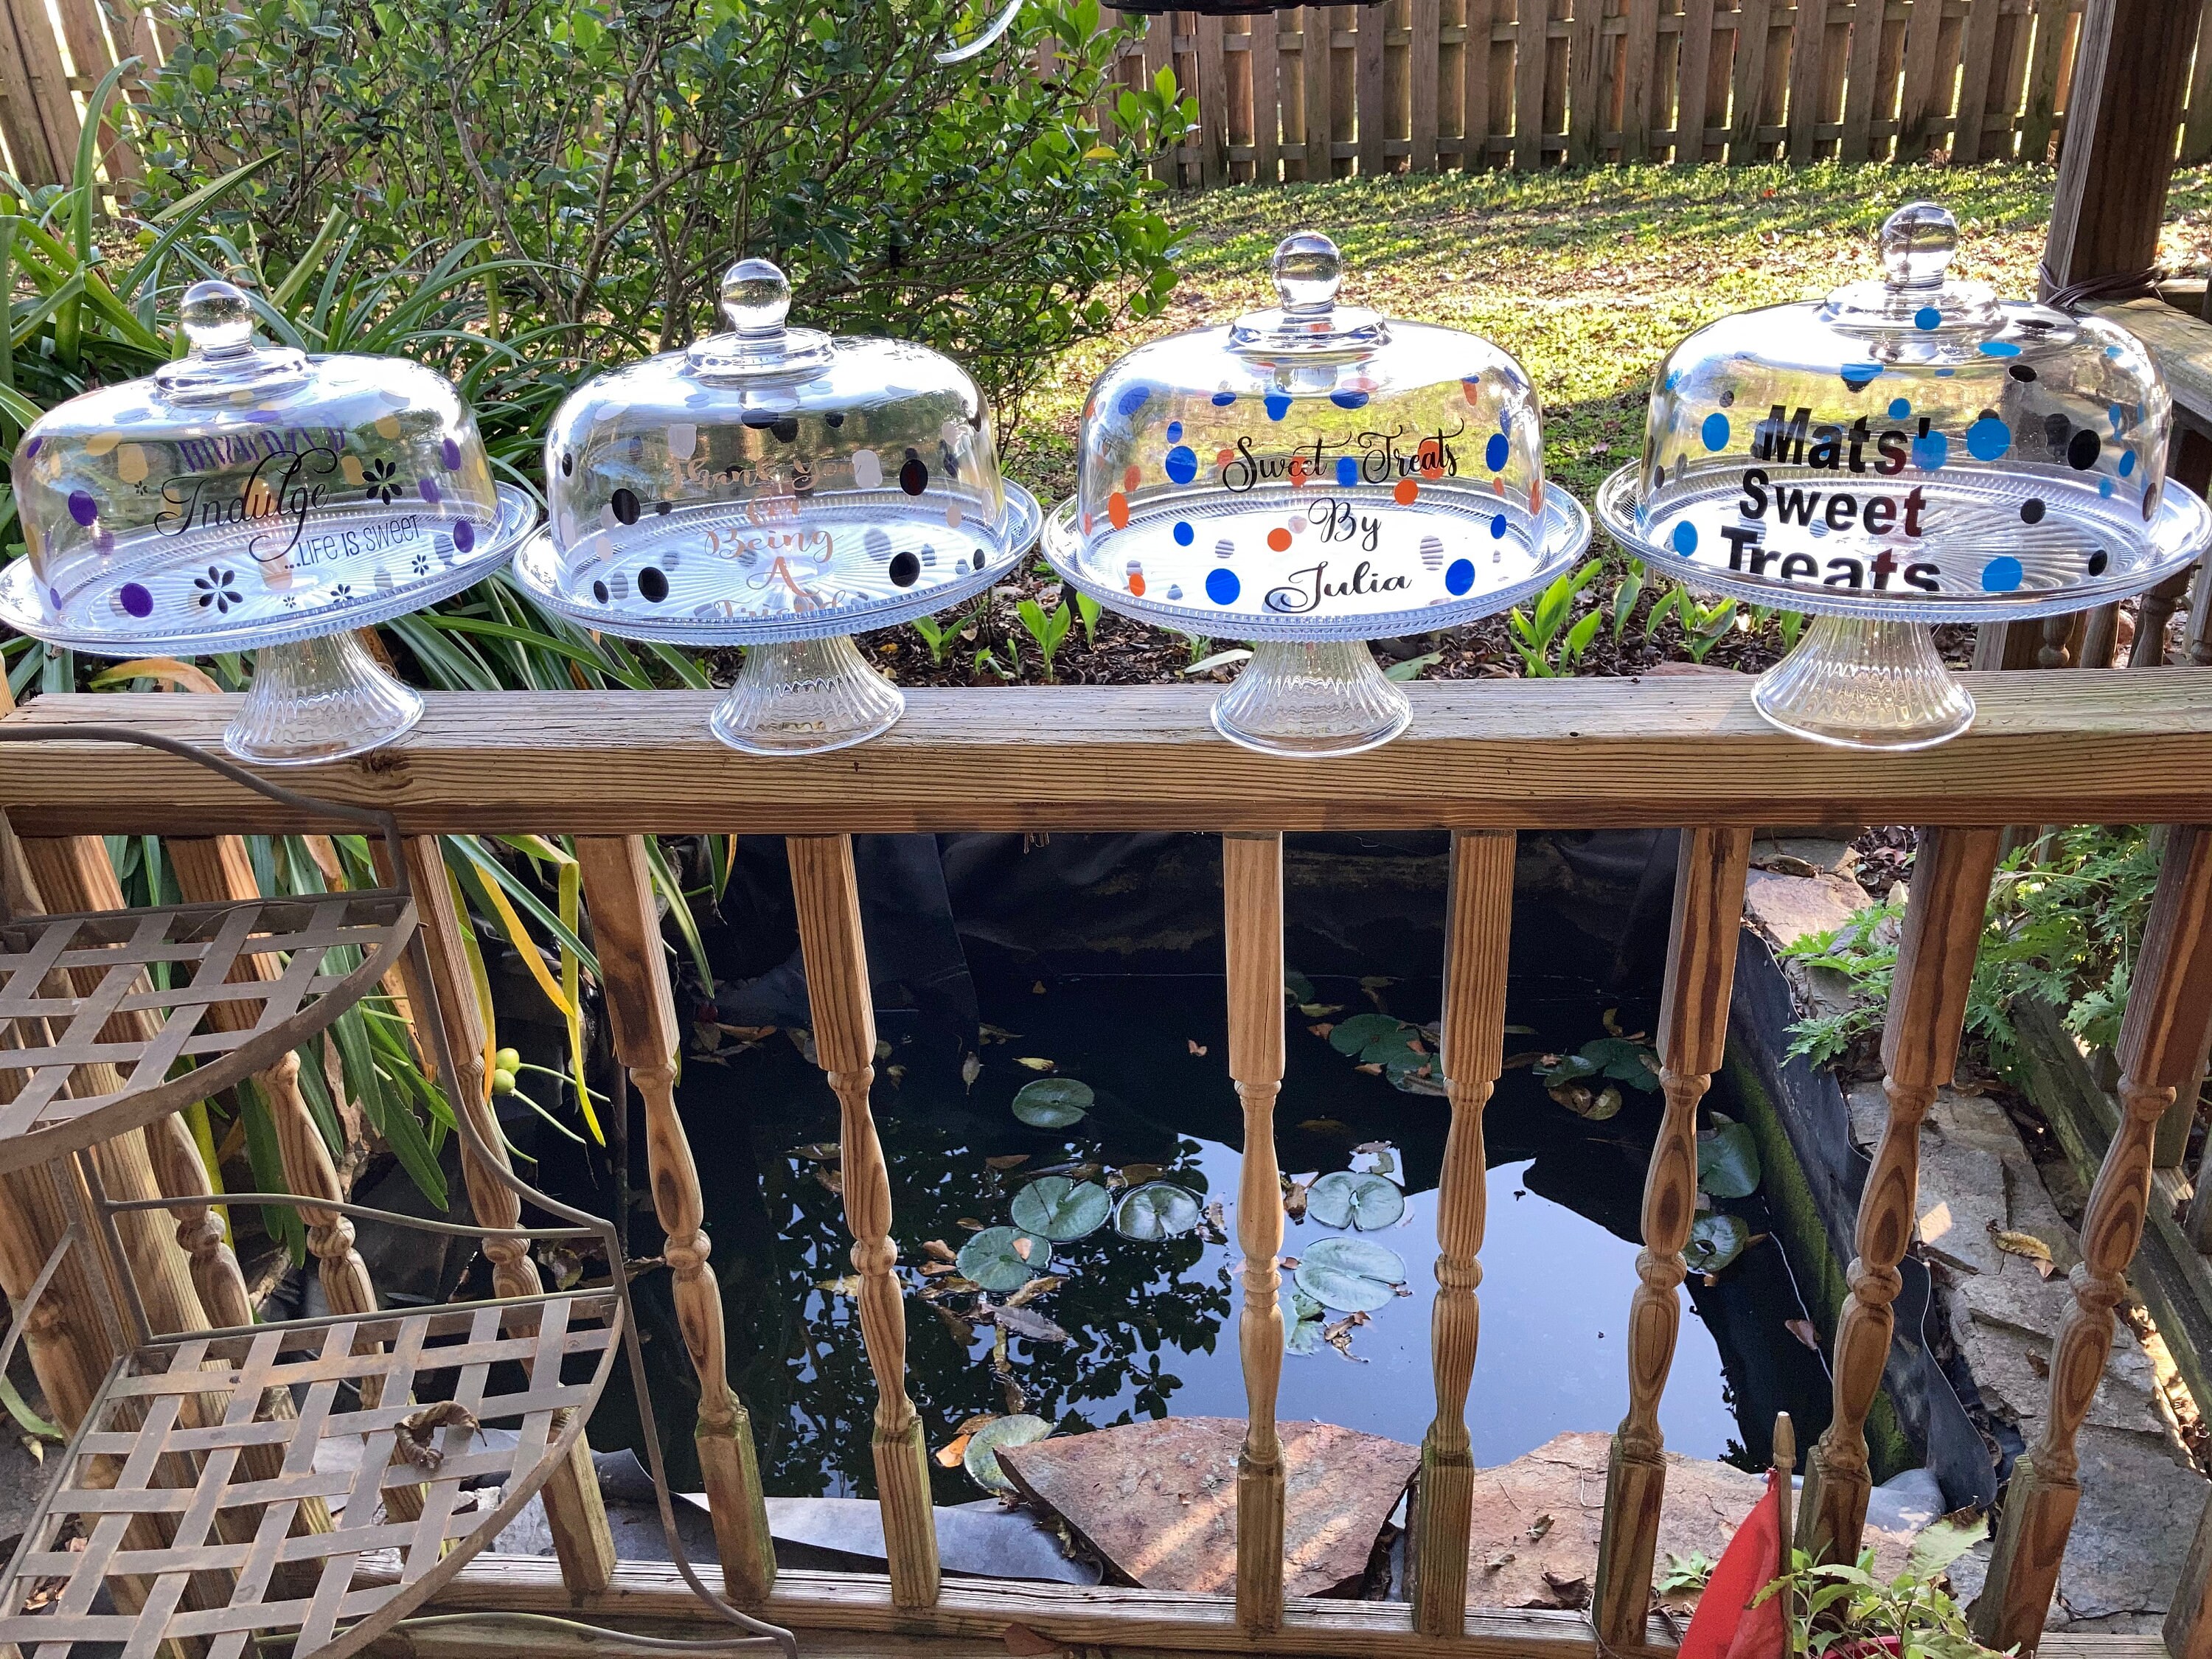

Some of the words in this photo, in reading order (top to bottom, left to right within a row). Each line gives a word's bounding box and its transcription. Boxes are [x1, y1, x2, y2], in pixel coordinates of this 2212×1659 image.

[1222, 431, 1352, 493] Sweet
[1357, 417, 1464, 484] Treats
[1762, 405, 1931, 476] Mats'
[154, 448, 338, 563] Indulge
[1308, 497, 1382, 552] By
[1739, 468, 1927, 538] Sweet
[341, 531, 360, 557] IS
[695, 526, 844, 563] Being
[1720, 525, 1941, 592] Treats
[746, 557, 820, 597] A
[1265, 561, 1412, 613] Julia
